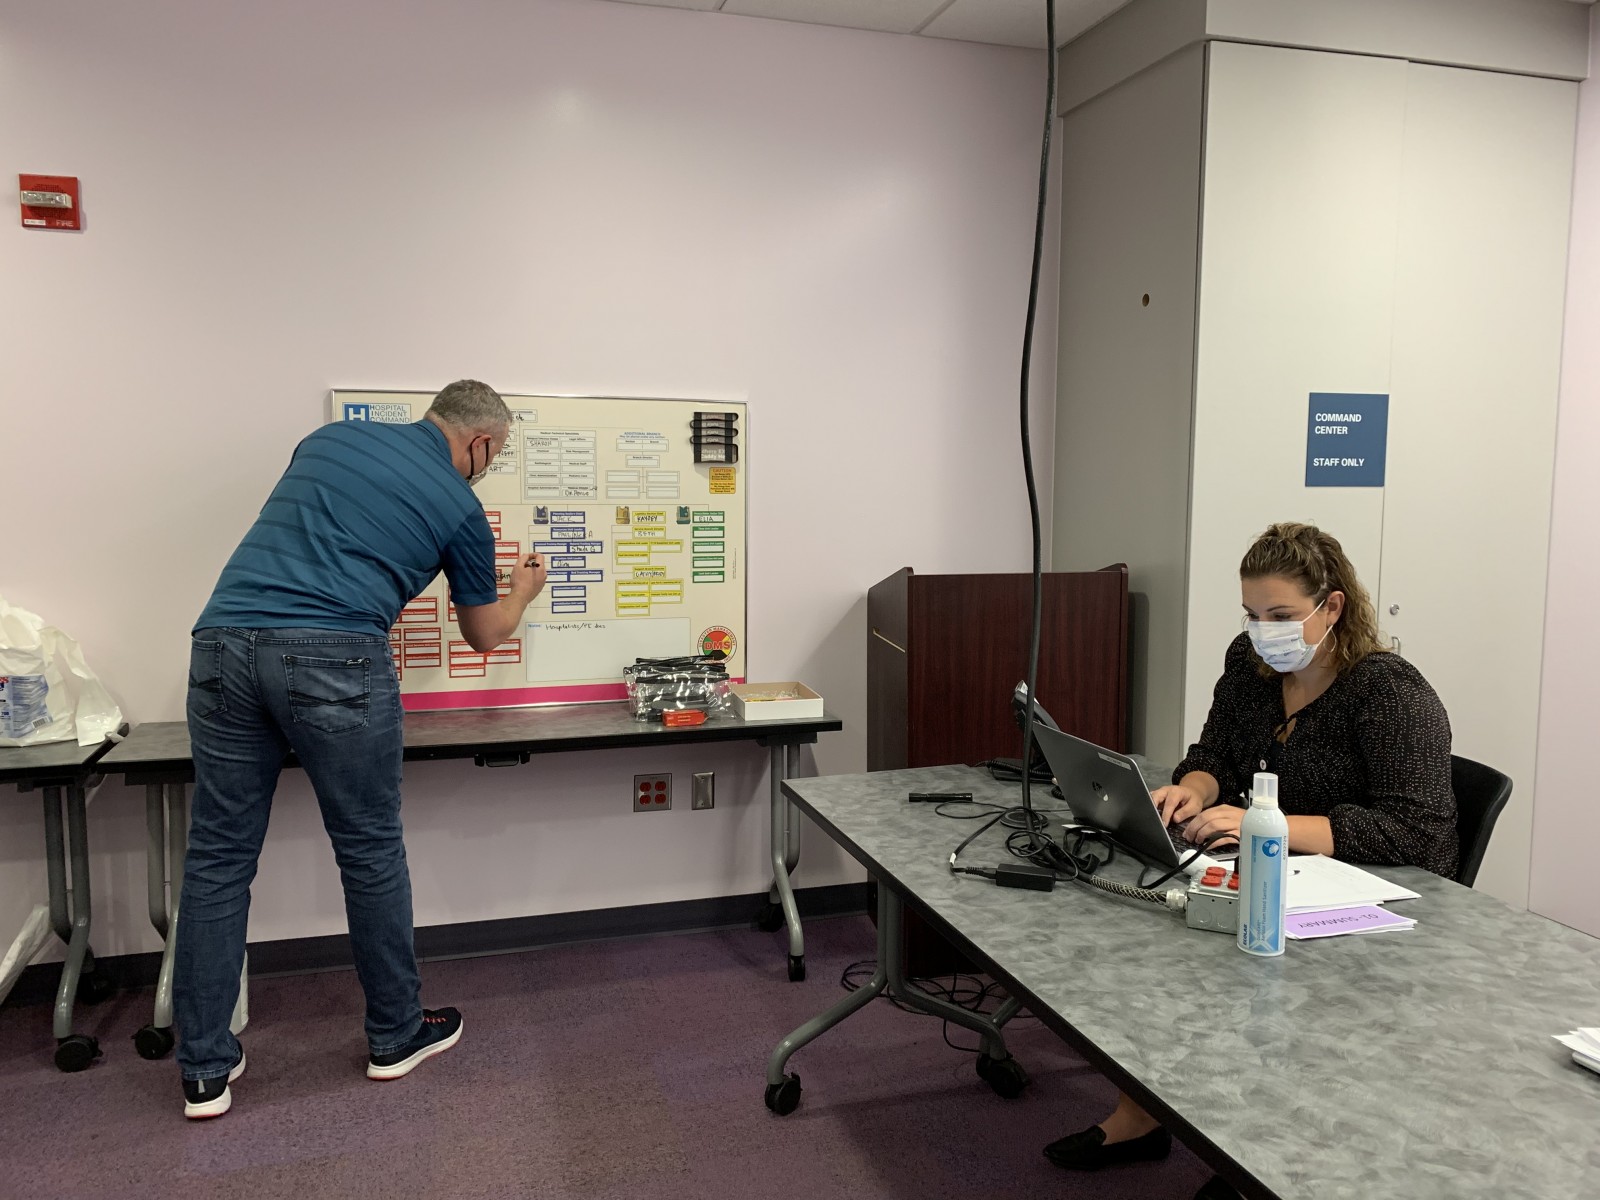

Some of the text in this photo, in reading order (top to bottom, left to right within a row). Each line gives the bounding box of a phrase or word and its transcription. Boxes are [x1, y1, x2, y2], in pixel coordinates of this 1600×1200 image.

[370, 404, 406, 412] HOSPITAL
[370, 416, 410, 424] COMMAND
[1315, 413, 1362, 422] COMMAND
[1314, 425, 1348, 435] CENTER
[1313, 458, 1365, 467] STAFF ONLY
[704, 640, 731, 651] DMS
